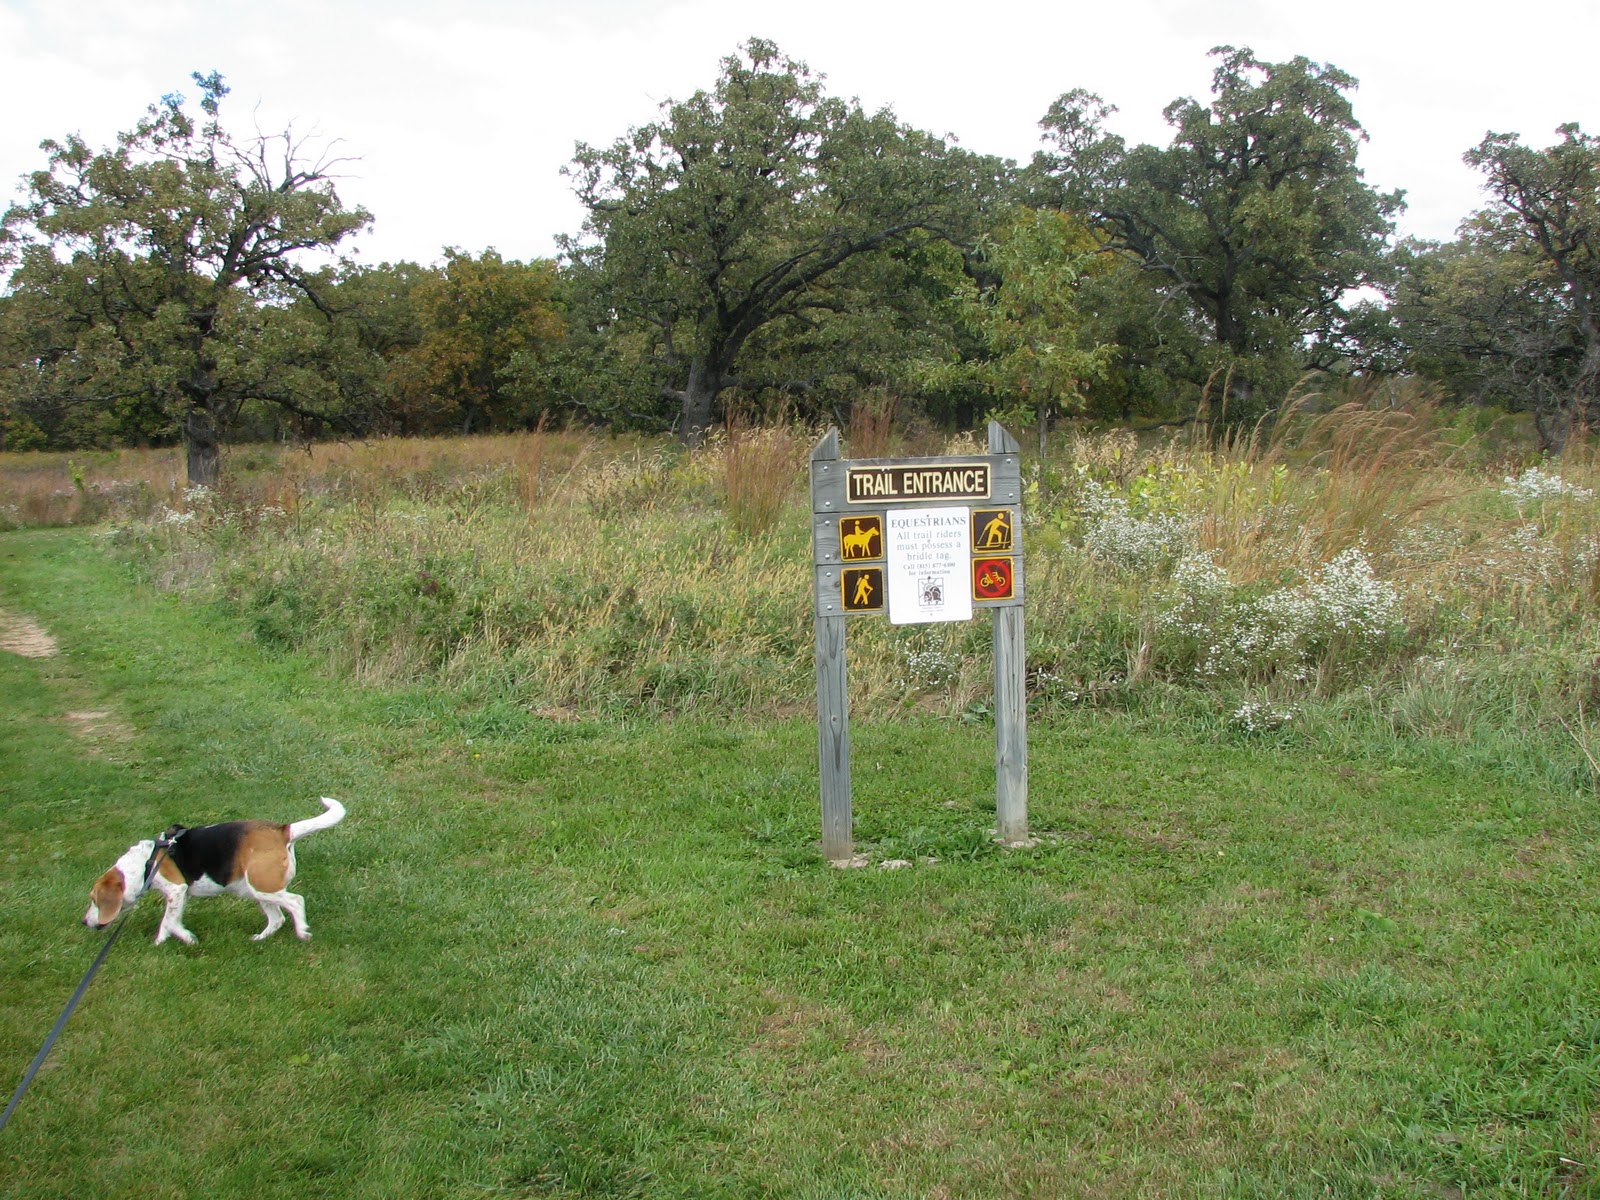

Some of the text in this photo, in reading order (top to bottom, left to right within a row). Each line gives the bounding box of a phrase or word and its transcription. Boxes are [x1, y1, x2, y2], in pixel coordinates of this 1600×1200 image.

[853, 470, 984, 495] TRAIL ENTRANCE
[891, 516, 966, 529] EQUESTRIANS
[896, 530, 962, 540] All trail riders
[896, 542, 918, 551] must
[921, 541, 953, 551] possess
[907, 552, 932, 560] bridle
